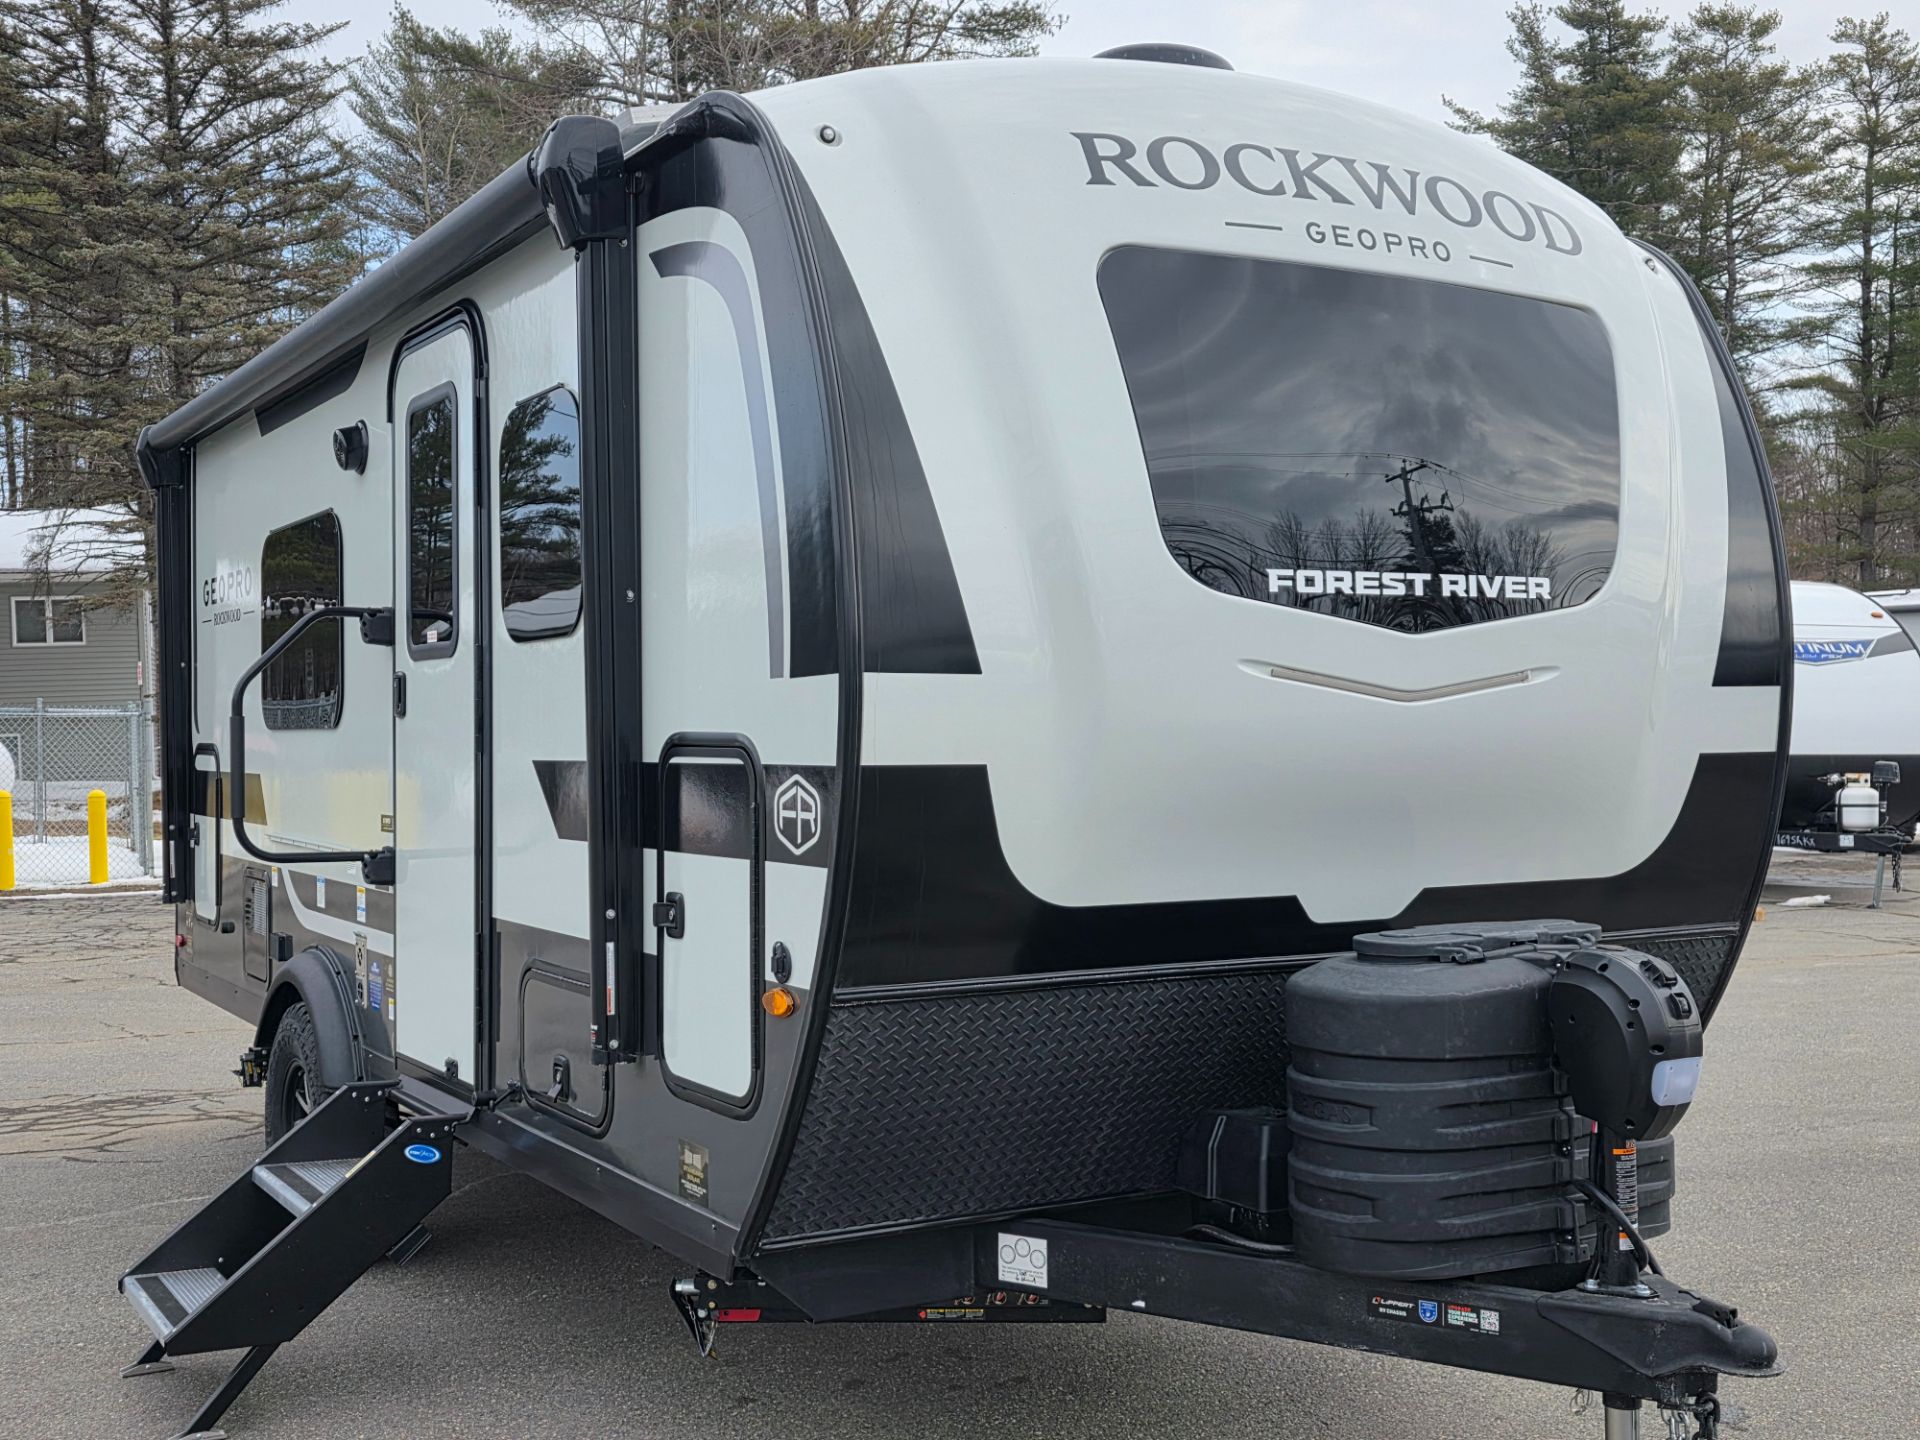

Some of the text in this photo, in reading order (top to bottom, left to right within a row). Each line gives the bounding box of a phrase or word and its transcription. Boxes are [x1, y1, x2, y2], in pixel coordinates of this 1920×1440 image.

[1070, 131, 1583, 257] ROCKWOOD
[1304, 221, 1452, 263] GEOPRO
[202, 566, 253, 607] GEOPRO
[1266, 568, 1552, 600] FOREST RIVER
[213, 608, 242, 626] ROCKWOOD
[1794, 642, 1866, 654] TINUM
